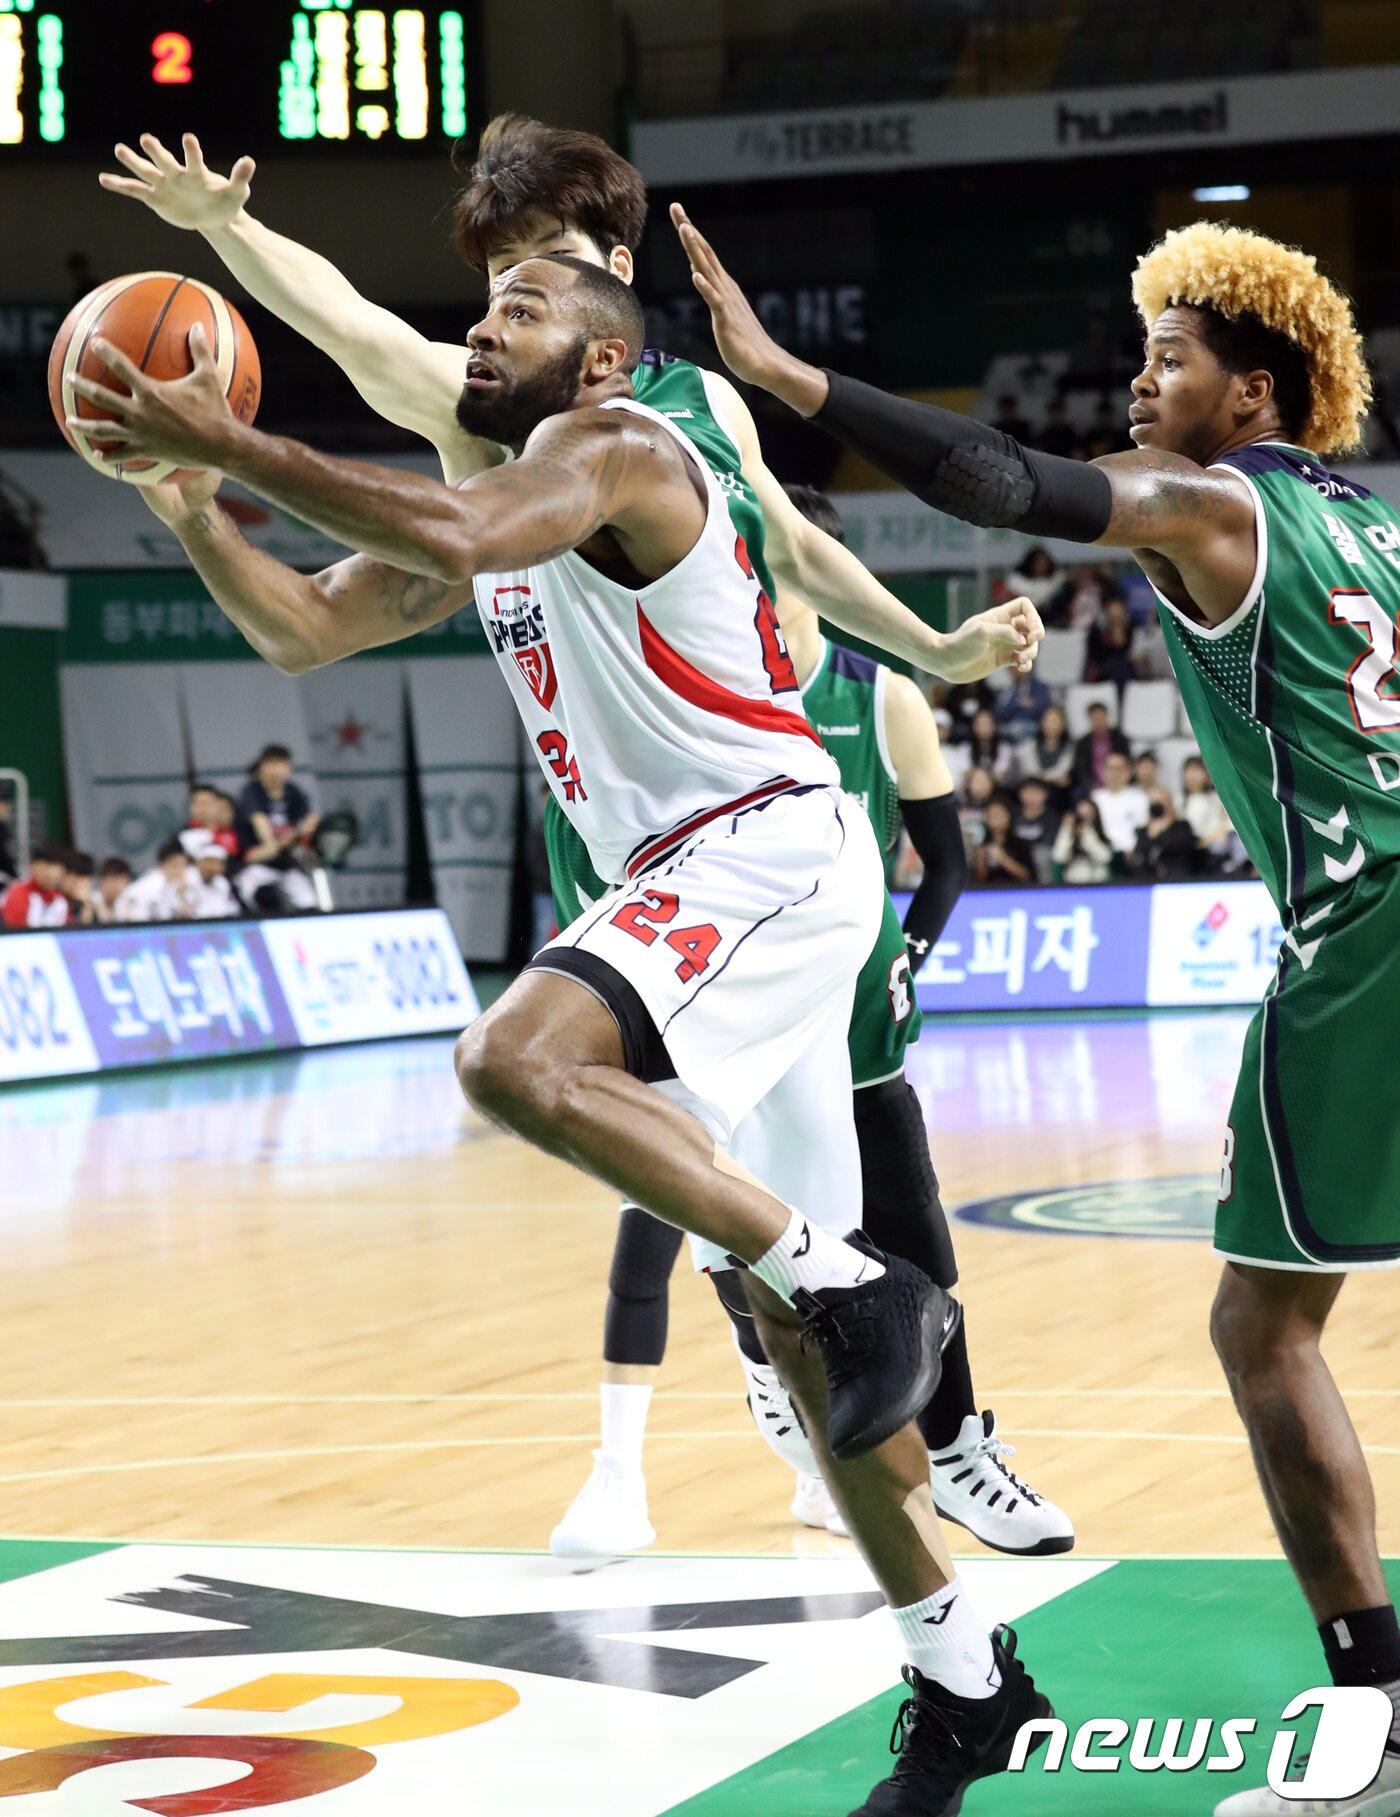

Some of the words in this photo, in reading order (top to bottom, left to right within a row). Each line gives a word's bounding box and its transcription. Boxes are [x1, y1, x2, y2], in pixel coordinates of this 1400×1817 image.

[151, 31, 193, 84] 2
[1056, 92, 1229, 144] hummel
[609, 888, 722, 984] 24
